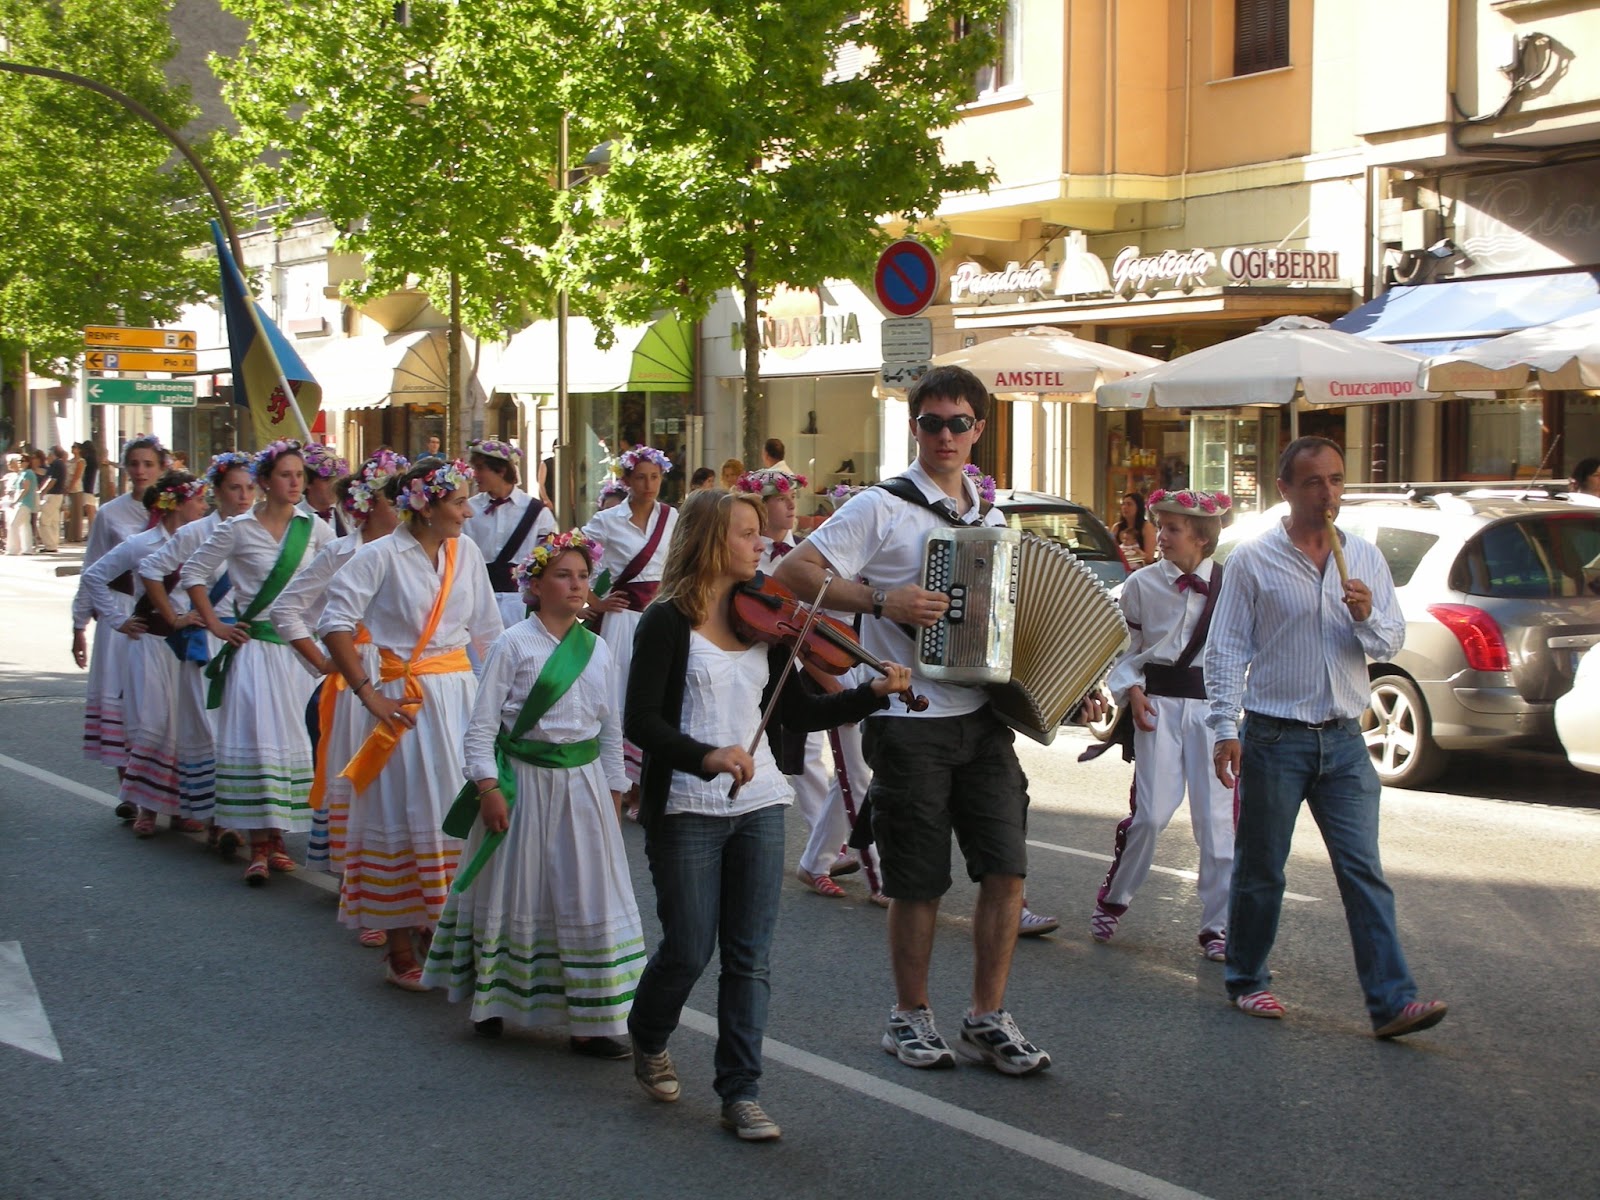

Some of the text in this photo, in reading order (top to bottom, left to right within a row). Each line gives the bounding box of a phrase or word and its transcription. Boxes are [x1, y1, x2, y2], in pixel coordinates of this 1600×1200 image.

[1112, 246, 1209, 293] Gozotegia
[88, 331, 120, 341] RENFE
[731, 312, 861, 351] MNDARINA
[106, 354, 118, 367] P
[995, 371, 1064, 387] AMSTEL
[1328, 380, 1413, 396] Cruzcampo
